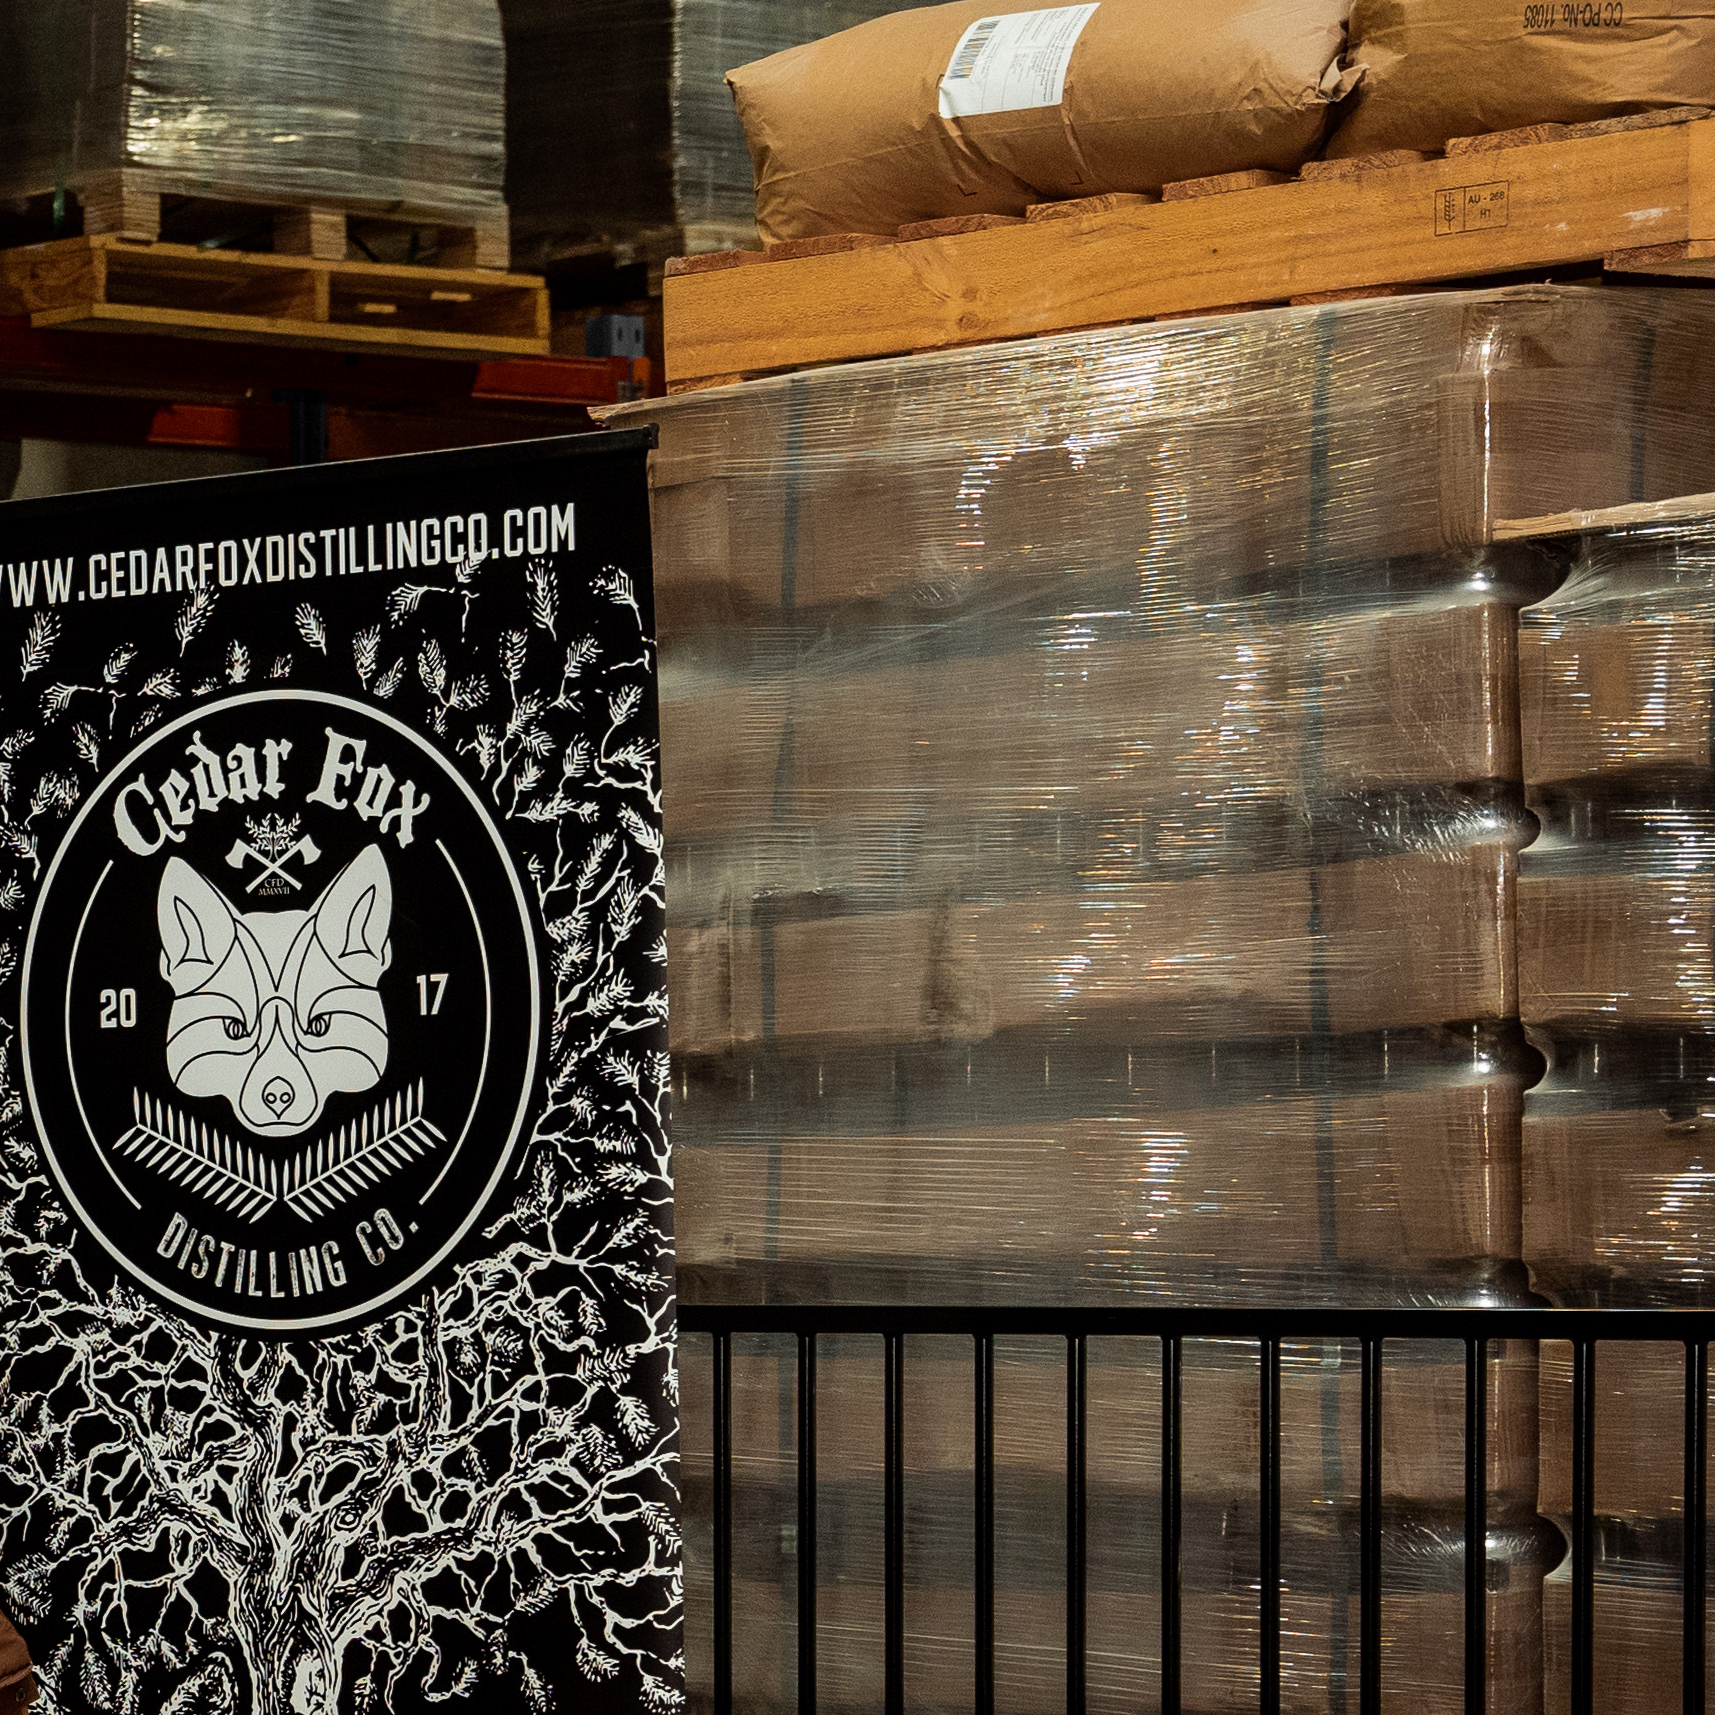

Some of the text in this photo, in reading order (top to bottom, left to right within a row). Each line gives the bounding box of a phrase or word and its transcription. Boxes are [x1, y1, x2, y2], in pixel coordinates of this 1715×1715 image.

[1604, 2, 1623, 27] CC
[1468, 194, 1481, 204] AU
[1480, 208, 1491, 219] HT
[112, 727, 431, 856] Cedar Fox
[264, 878, 284, 887] CFD
[100, 988, 136, 1028] 20
[417, 973, 448, 1015] 17
[157, 1207, 419, 1297] DISTILLING CO.
